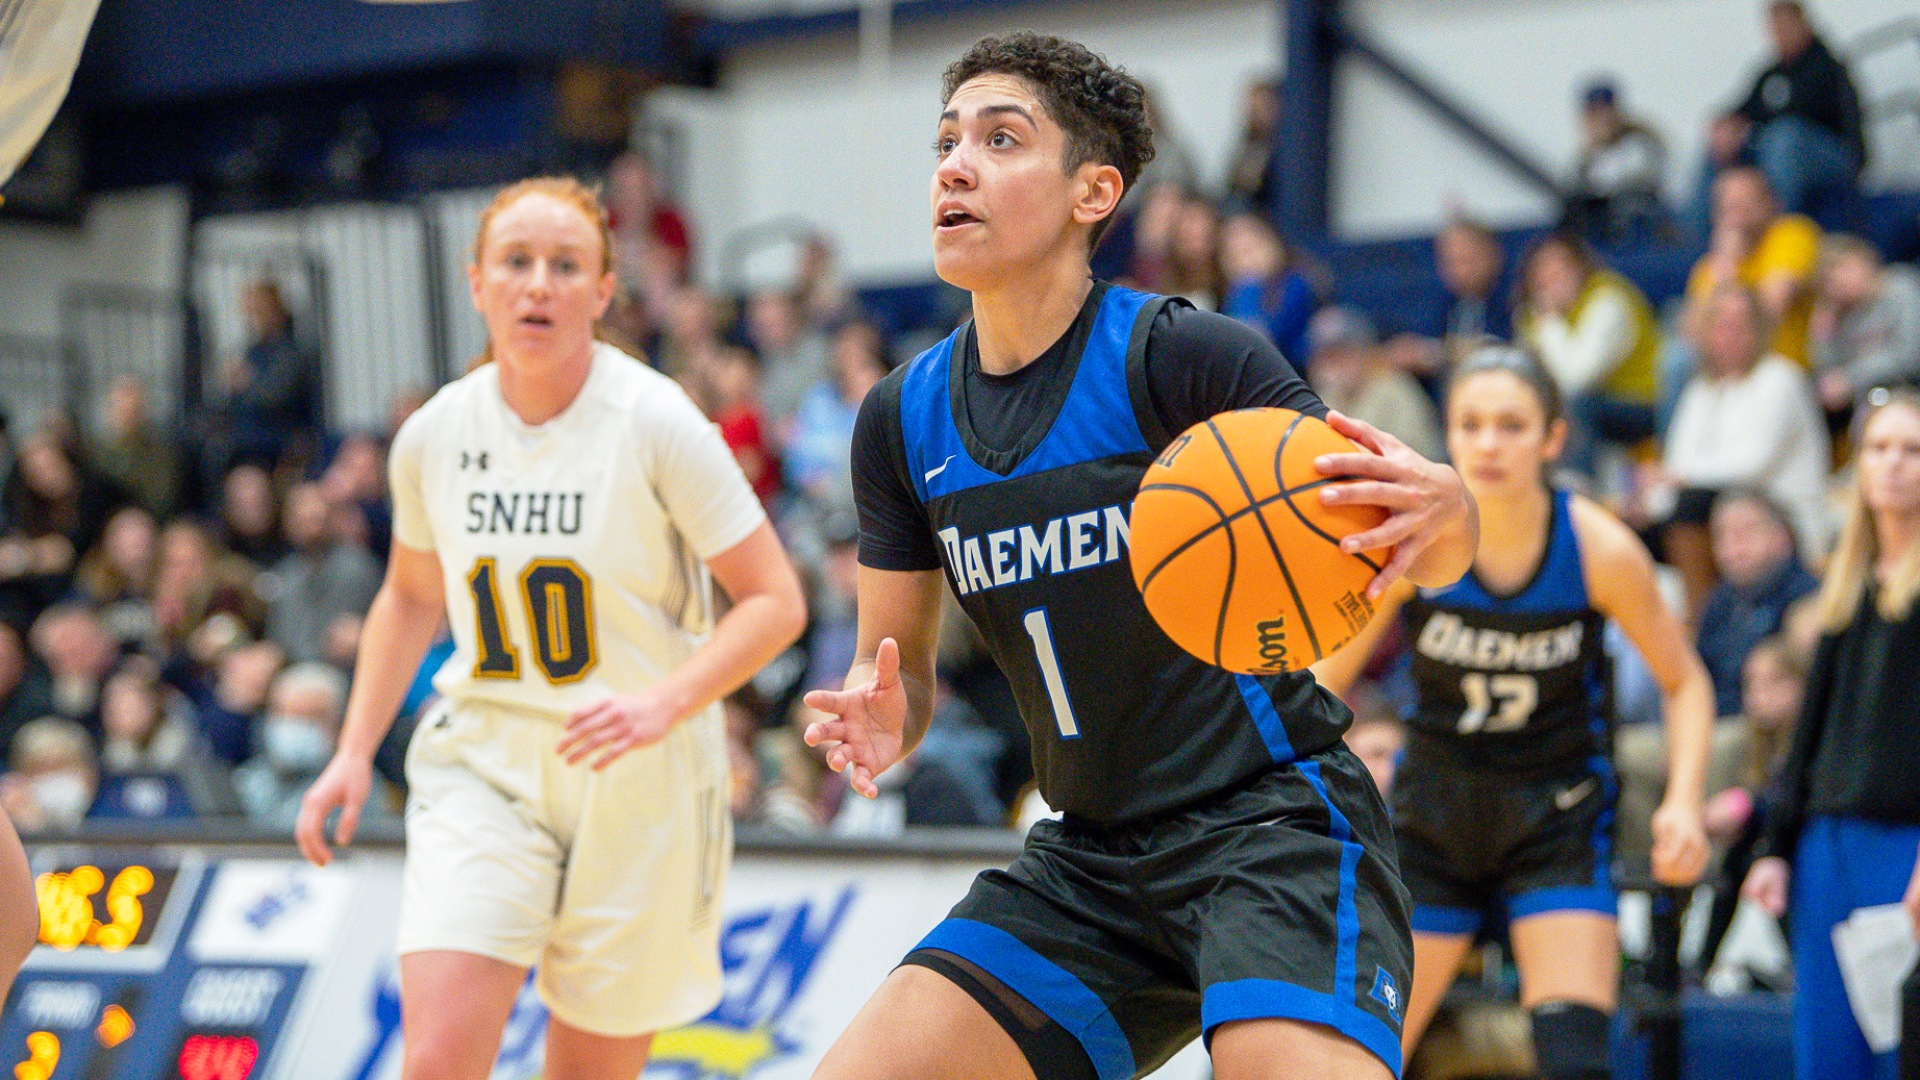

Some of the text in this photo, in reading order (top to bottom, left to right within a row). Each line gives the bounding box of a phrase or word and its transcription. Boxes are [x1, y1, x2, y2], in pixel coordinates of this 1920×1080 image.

[466, 492, 584, 535] SNHU
[465, 556, 598, 687] 10
[1022, 606, 1082, 740] 1
